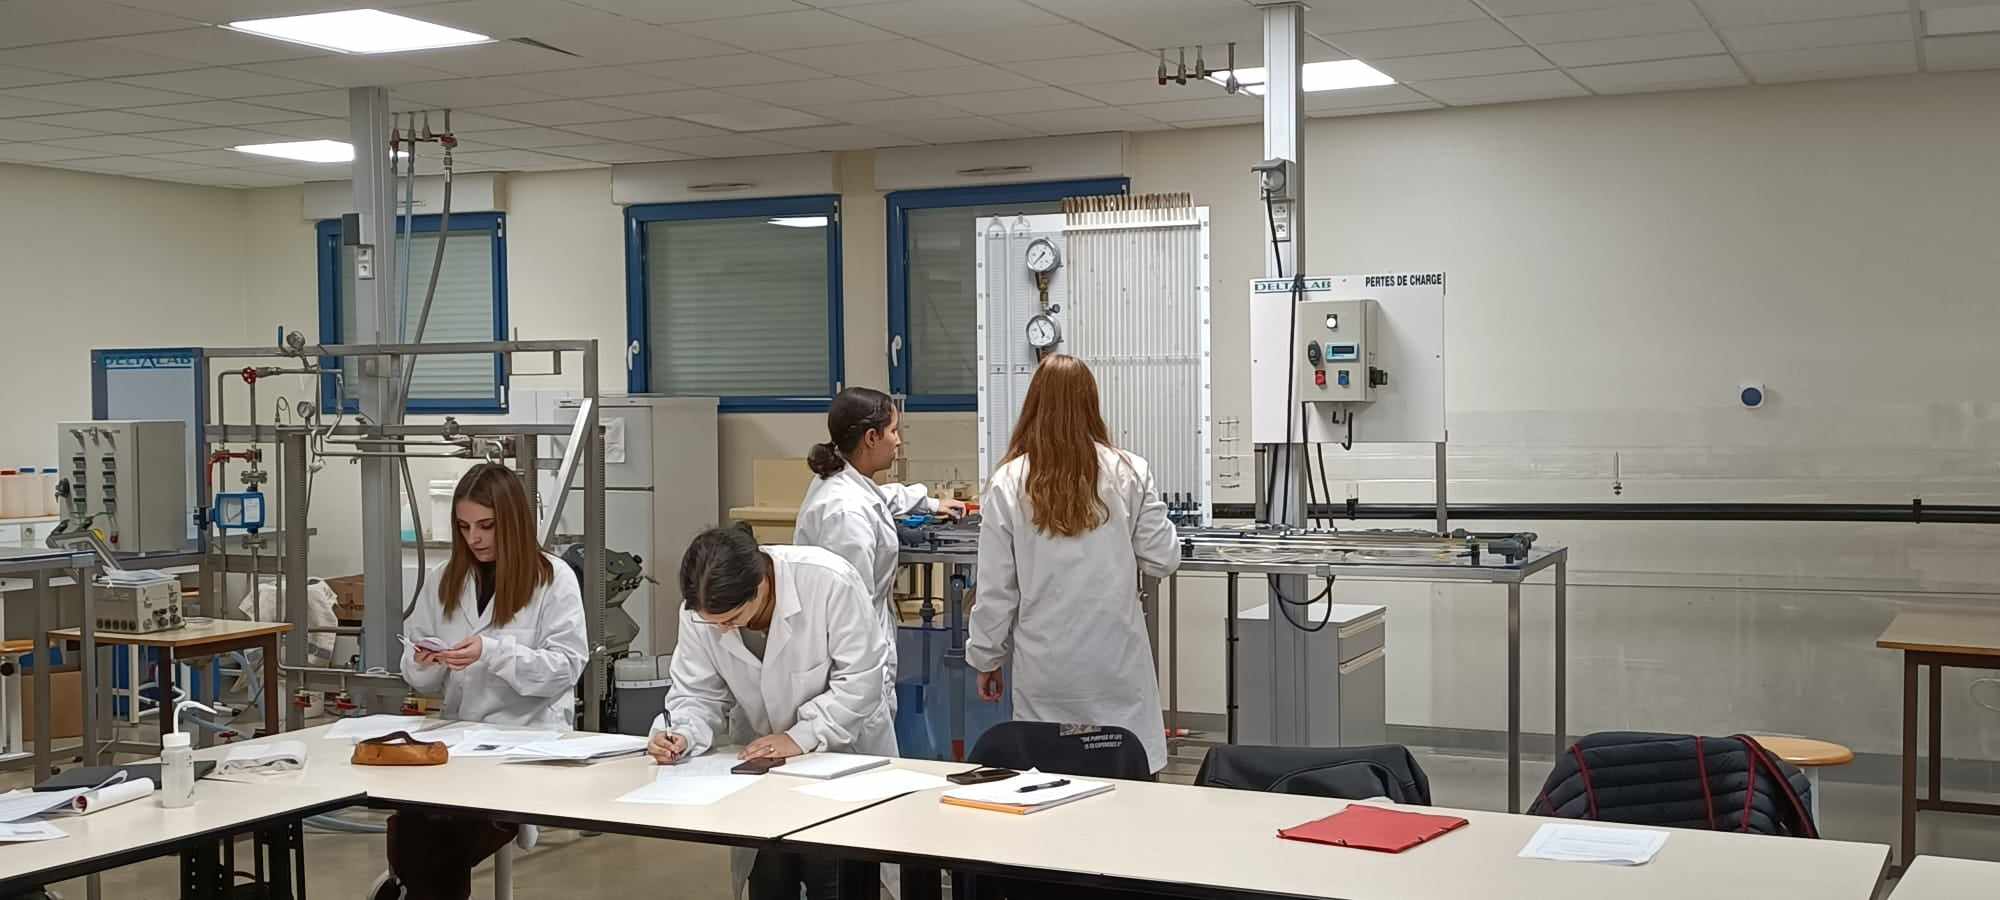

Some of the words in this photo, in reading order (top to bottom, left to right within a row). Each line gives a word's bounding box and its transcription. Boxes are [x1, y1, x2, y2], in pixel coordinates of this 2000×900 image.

[1365, 275, 1395, 288] PERTES
[1397, 275, 1408, 286] DE
[1410, 273, 1442, 286] CHARGE
